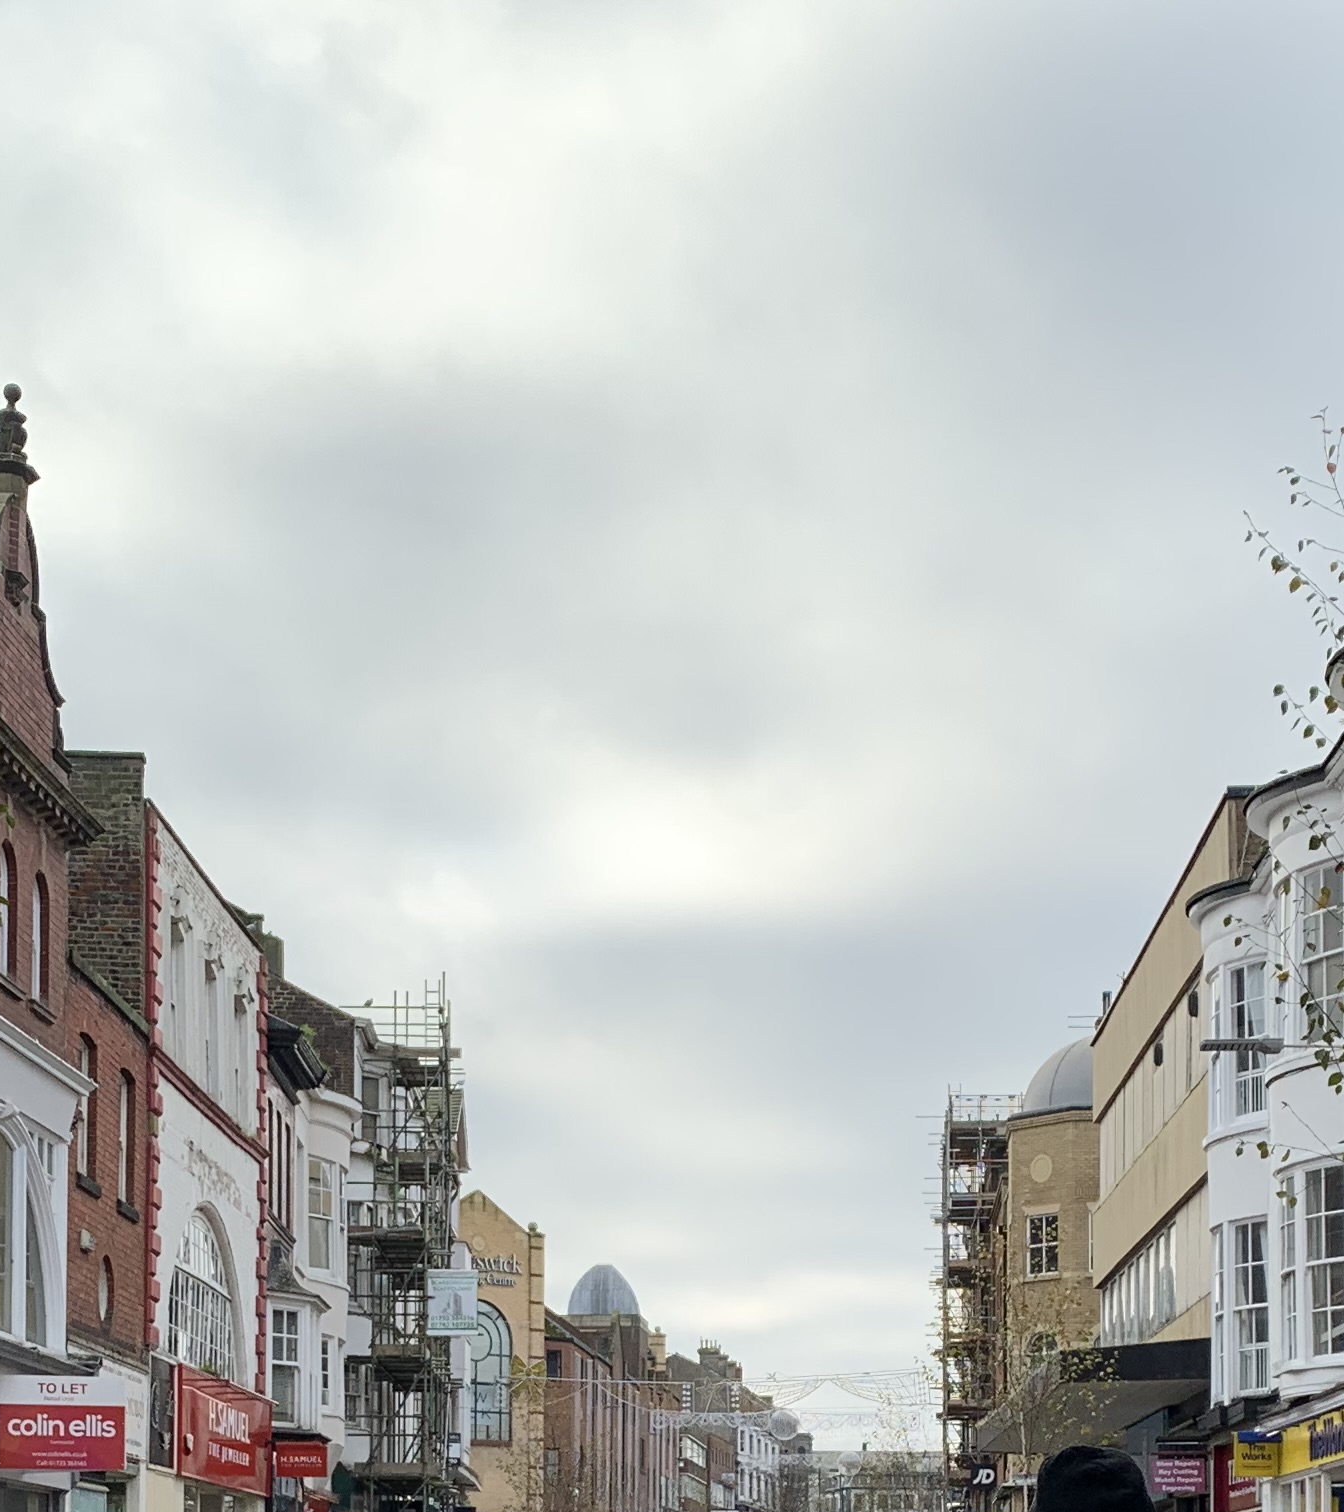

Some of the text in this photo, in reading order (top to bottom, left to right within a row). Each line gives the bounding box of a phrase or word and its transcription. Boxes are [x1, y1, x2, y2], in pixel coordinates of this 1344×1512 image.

[38, 1383, 88, 1394] TO LET
[7, 1413, 116, 1437] colin ellis
[208, 1441, 250, 1466] THE JEWELLER
[1241, 1452, 1272, 1461] Works
[972, 1468, 995, 1485] JD
[1173, 1468, 1198, 1476] Cutting
